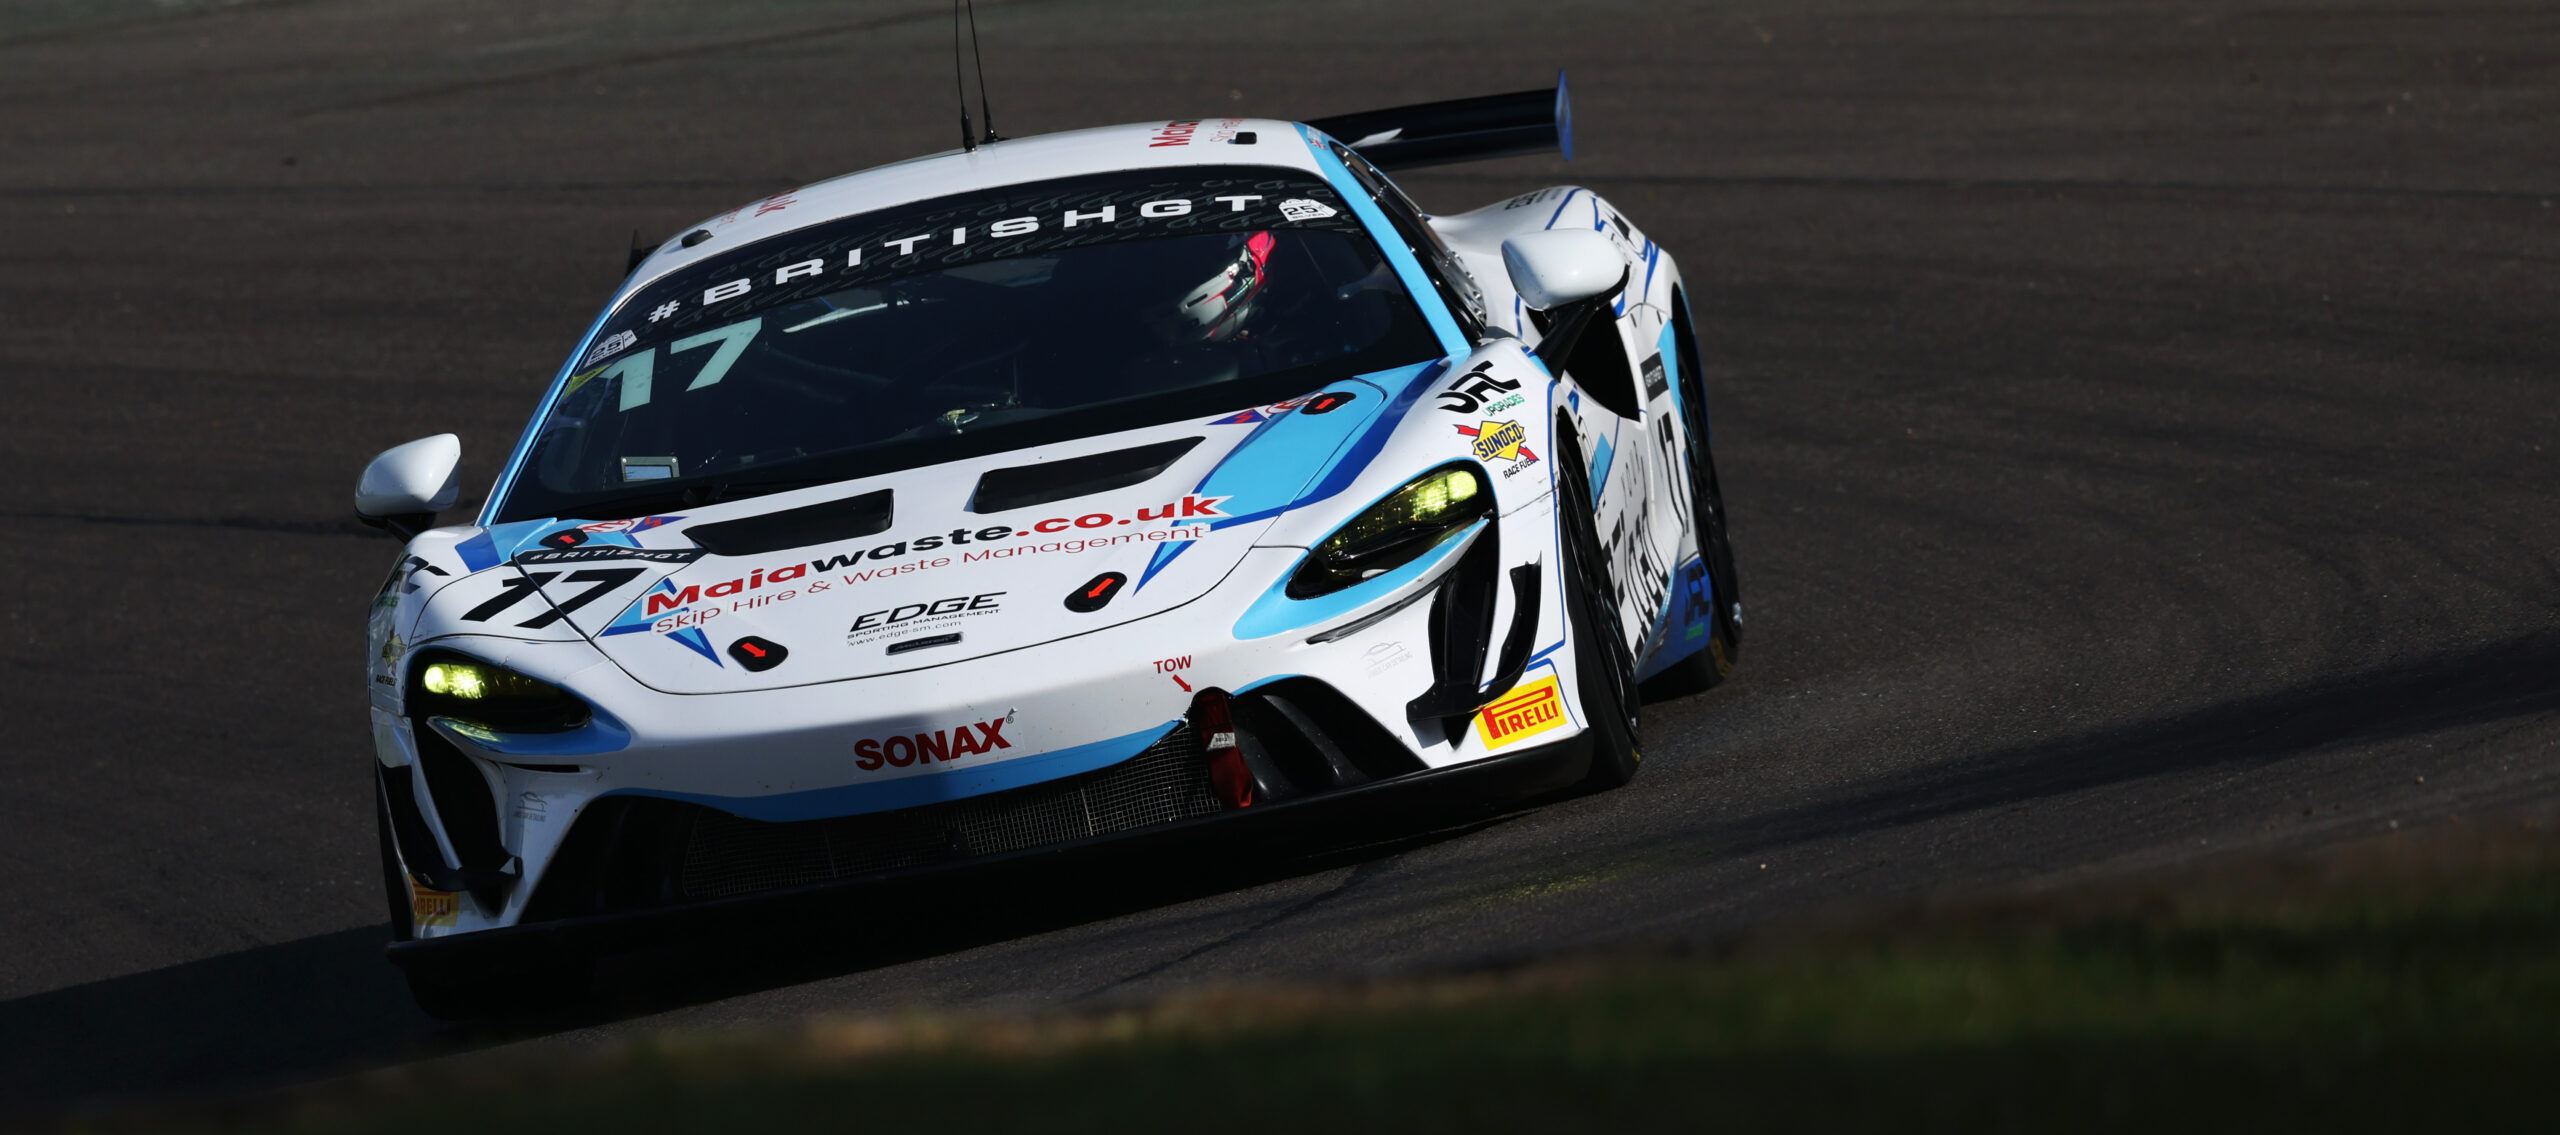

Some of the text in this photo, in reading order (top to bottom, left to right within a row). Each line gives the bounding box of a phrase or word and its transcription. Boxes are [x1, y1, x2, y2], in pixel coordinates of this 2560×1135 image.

[1283, 205, 1318, 216] 25
[647, 194, 1263, 323] #BRITISHGT
[598, 316, 762, 413] 17
[1482, 393, 1526, 417] UPGRADES
[1475, 423, 1523, 459] SUNOCO
[1503, 455, 1537, 479] RACE FUEL
[529, 549, 692, 561] #BRITISHGT
[646, 496, 1220, 617] Maiawaste.co.uk
[460, 567, 648, 630] 17
[655, 525, 1205, 634] Skip Hire & Waste Management
[847, 608, 1001, 640] SPORTING MANAGEMENT
[849, 591, 1008, 633] EDGE
[1153, 655, 1192, 674] TOW
[1482, 685, 1559, 740] PIRELLI
[853, 716, 1012, 771] SONAX
